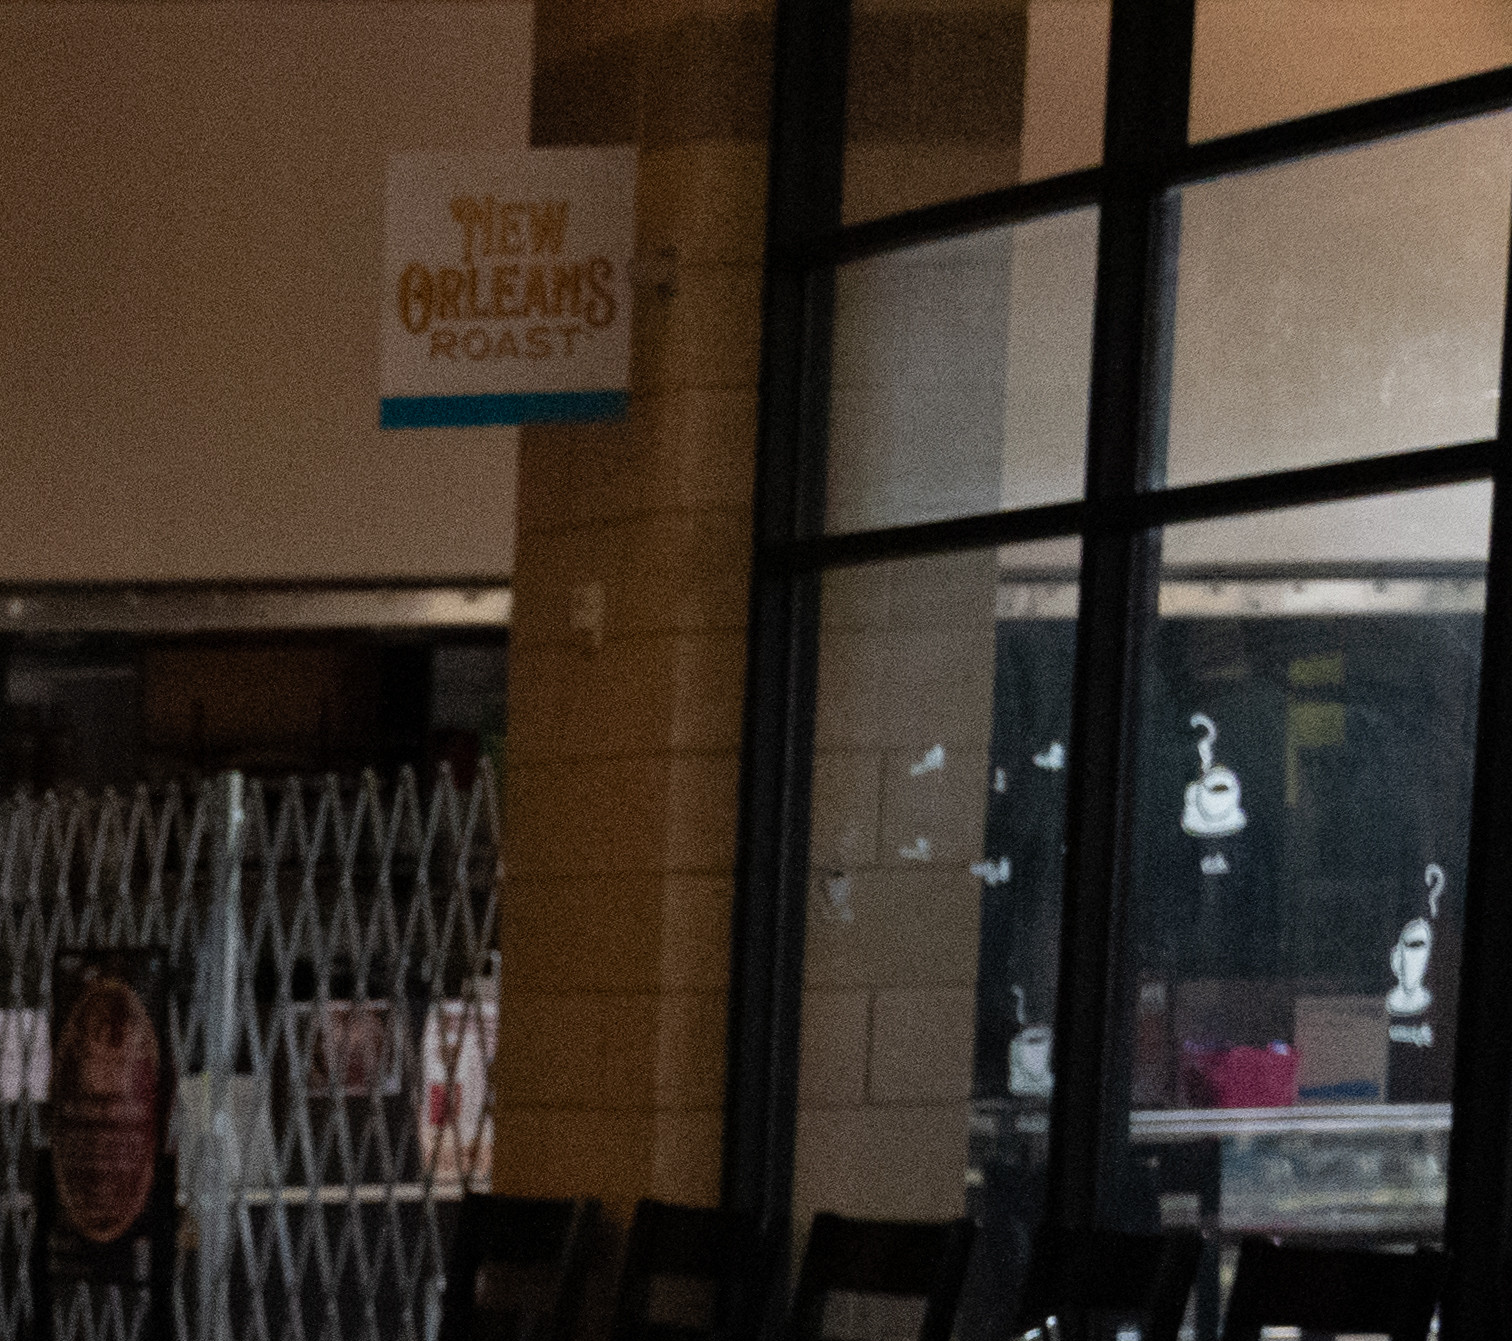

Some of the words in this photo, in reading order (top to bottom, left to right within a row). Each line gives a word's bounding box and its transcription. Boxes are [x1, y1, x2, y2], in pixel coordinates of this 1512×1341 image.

[450, 196, 569, 262] NEW
[398, 256, 616, 336] ORLEANS
[429, 326, 582, 361] ROAST
